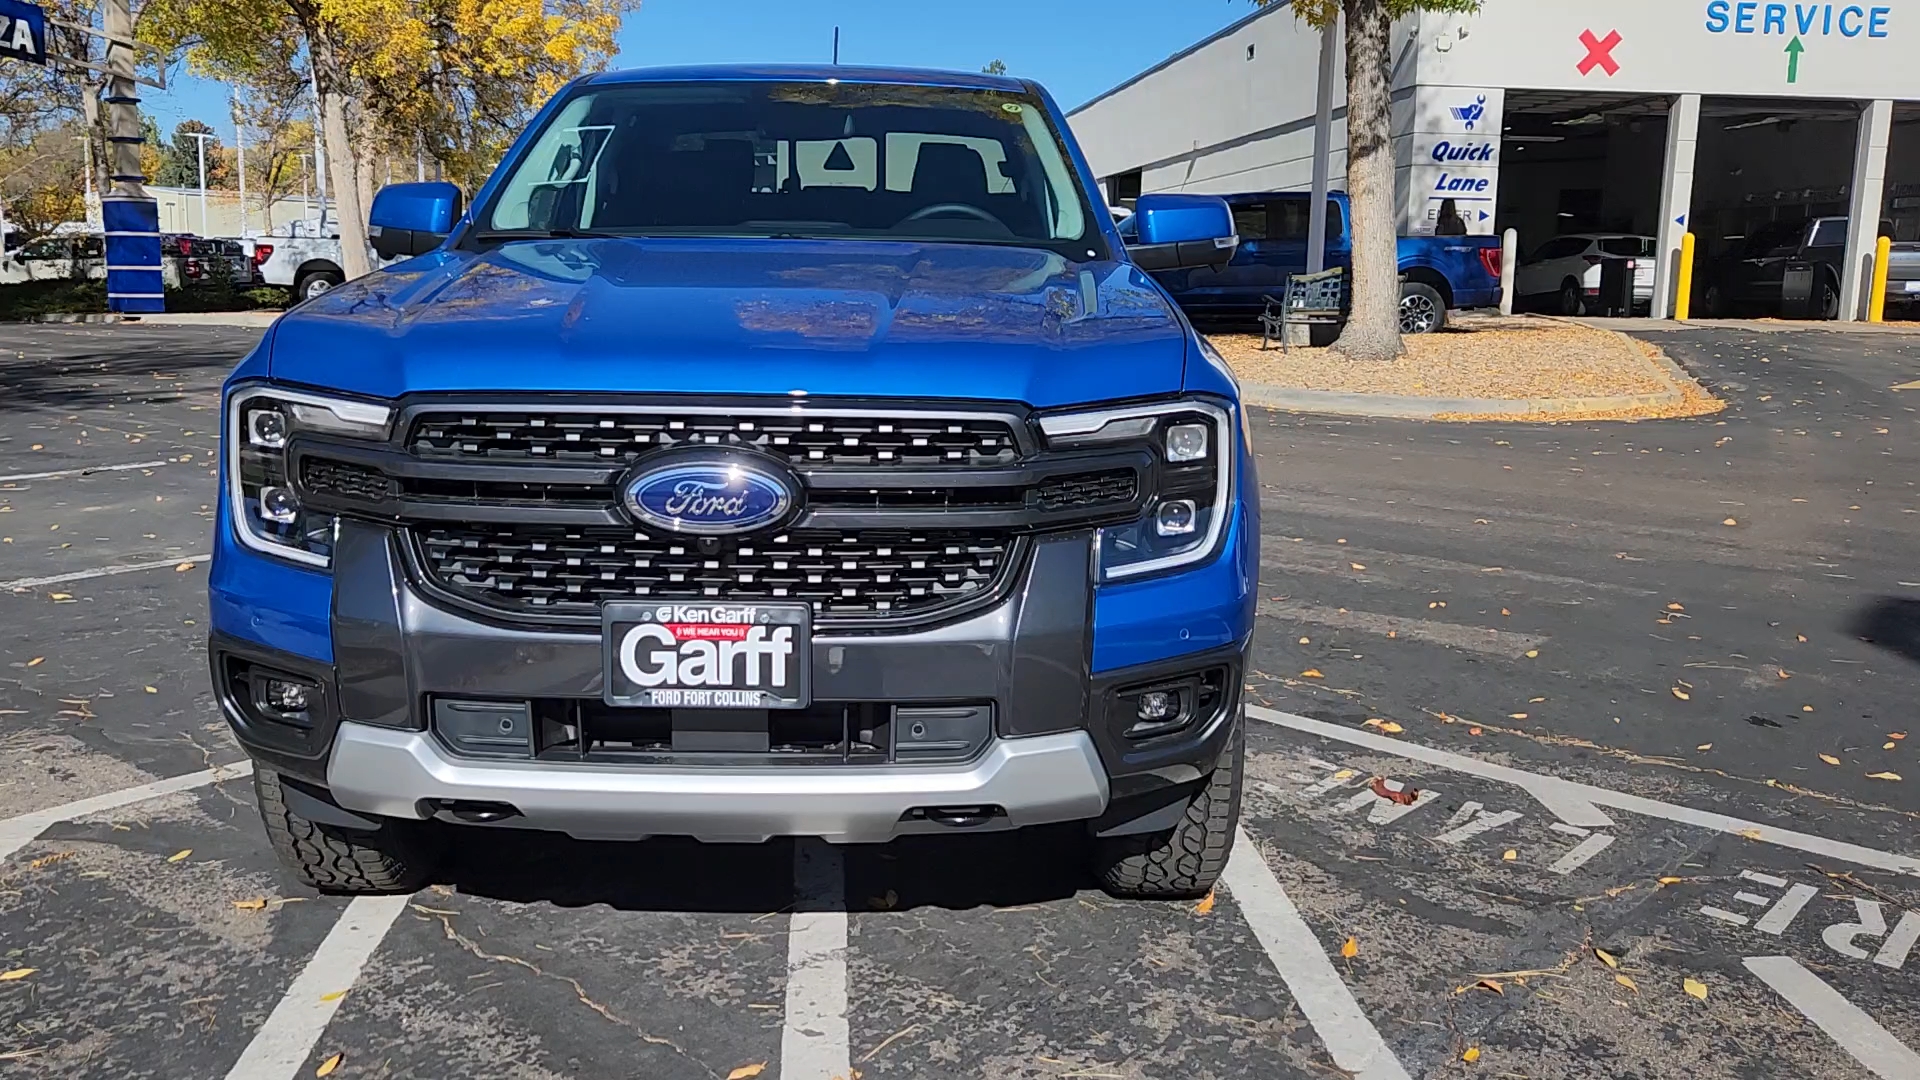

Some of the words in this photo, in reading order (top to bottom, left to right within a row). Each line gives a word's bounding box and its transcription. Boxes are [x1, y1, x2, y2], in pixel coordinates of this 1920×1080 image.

[1705, 1, 1891, 38] SERVICE
[1432, 141, 1495, 162] Quick
[1435, 173, 1489, 191] Lane
[1428, 208, 1472, 221] EER
[665, 480, 748, 516] Ford
[673, 606, 710, 622] Ken
[711, 606, 757, 623] Garff
[682, 627, 696, 637] WE
[697, 627, 720, 637] HEAR
[721, 627, 739, 637] YOU
[620, 623, 793, 687] Garff
[651, 691, 682, 705] FORD
[683, 691, 712, 706] FORT
[714, 691, 761, 706] COLLINS
